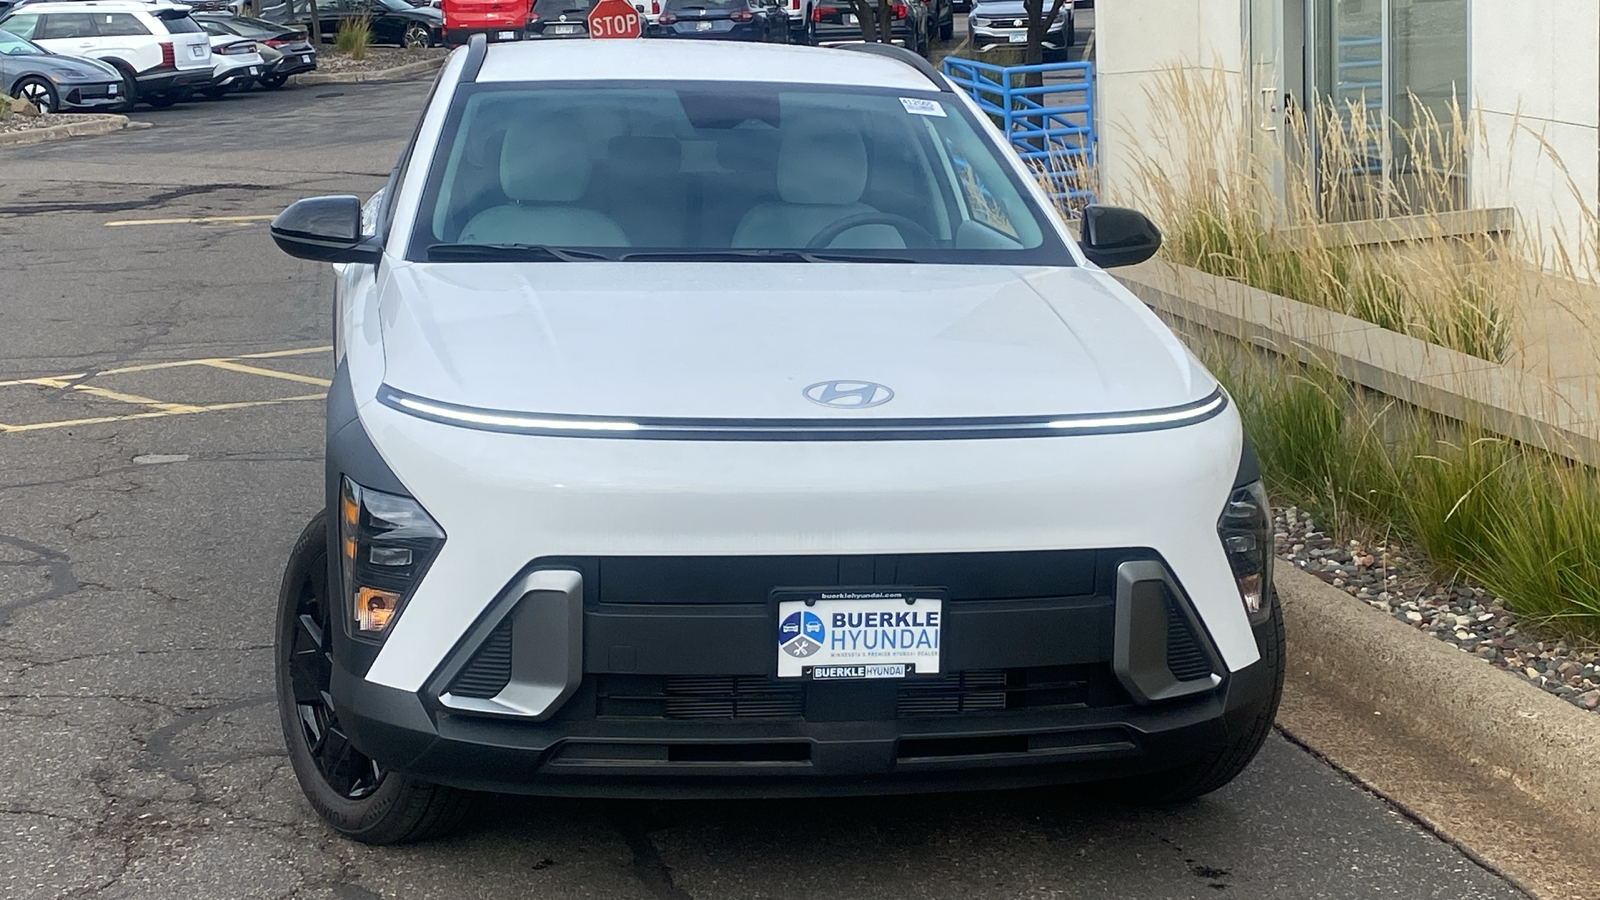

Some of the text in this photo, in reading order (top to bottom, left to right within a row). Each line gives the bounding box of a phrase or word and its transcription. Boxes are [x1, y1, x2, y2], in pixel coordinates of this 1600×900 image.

[592, 14, 637, 37] STOP
[832, 612, 939, 628] BUERKLE
[831, 629, 938, 650] HYUNDAI
[815, 666, 904, 678] BUERKLE HYUNDAI
